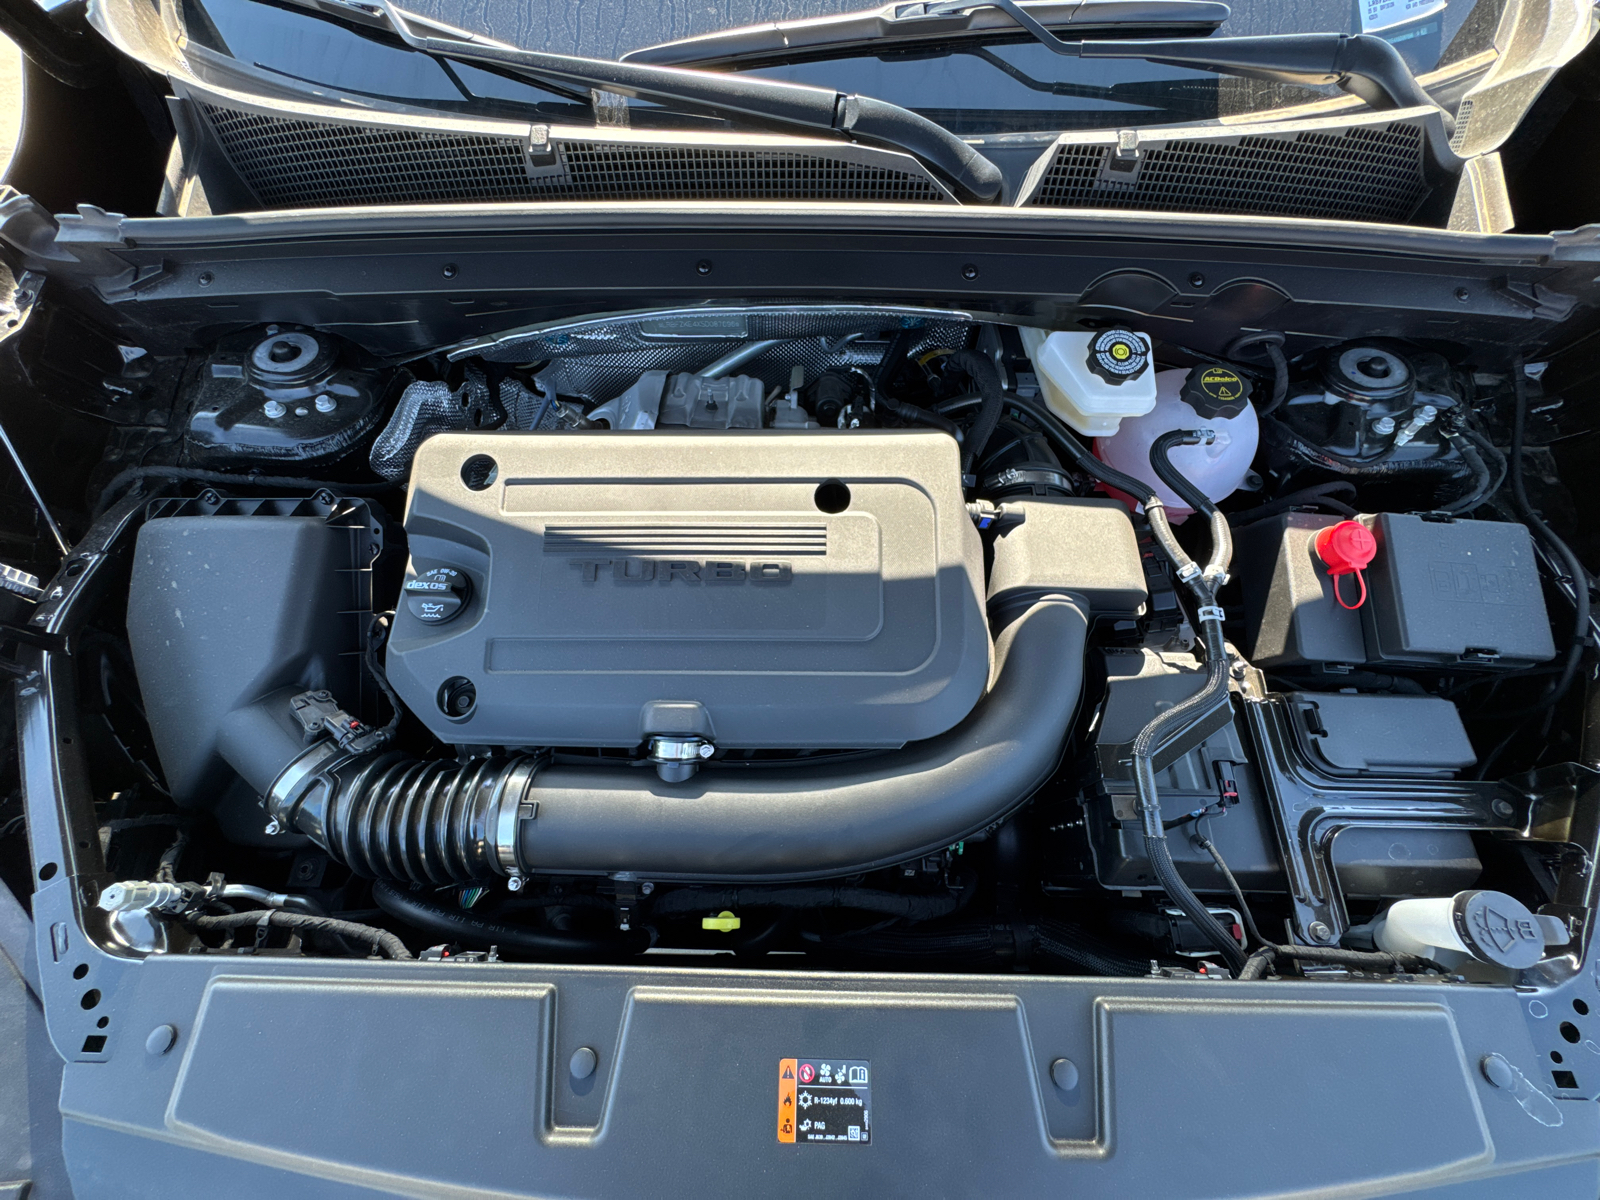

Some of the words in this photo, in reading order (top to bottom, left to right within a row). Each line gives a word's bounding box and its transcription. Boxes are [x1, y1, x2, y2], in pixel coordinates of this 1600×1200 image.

[569, 558, 793, 583] TURBO
[406, 580, 449, 590] dexos
[813, 1096, 838, 1106] R-1234yf
[855, 1098, 863, 1107] kg
[813, 1121, 826, 1130] PAG
